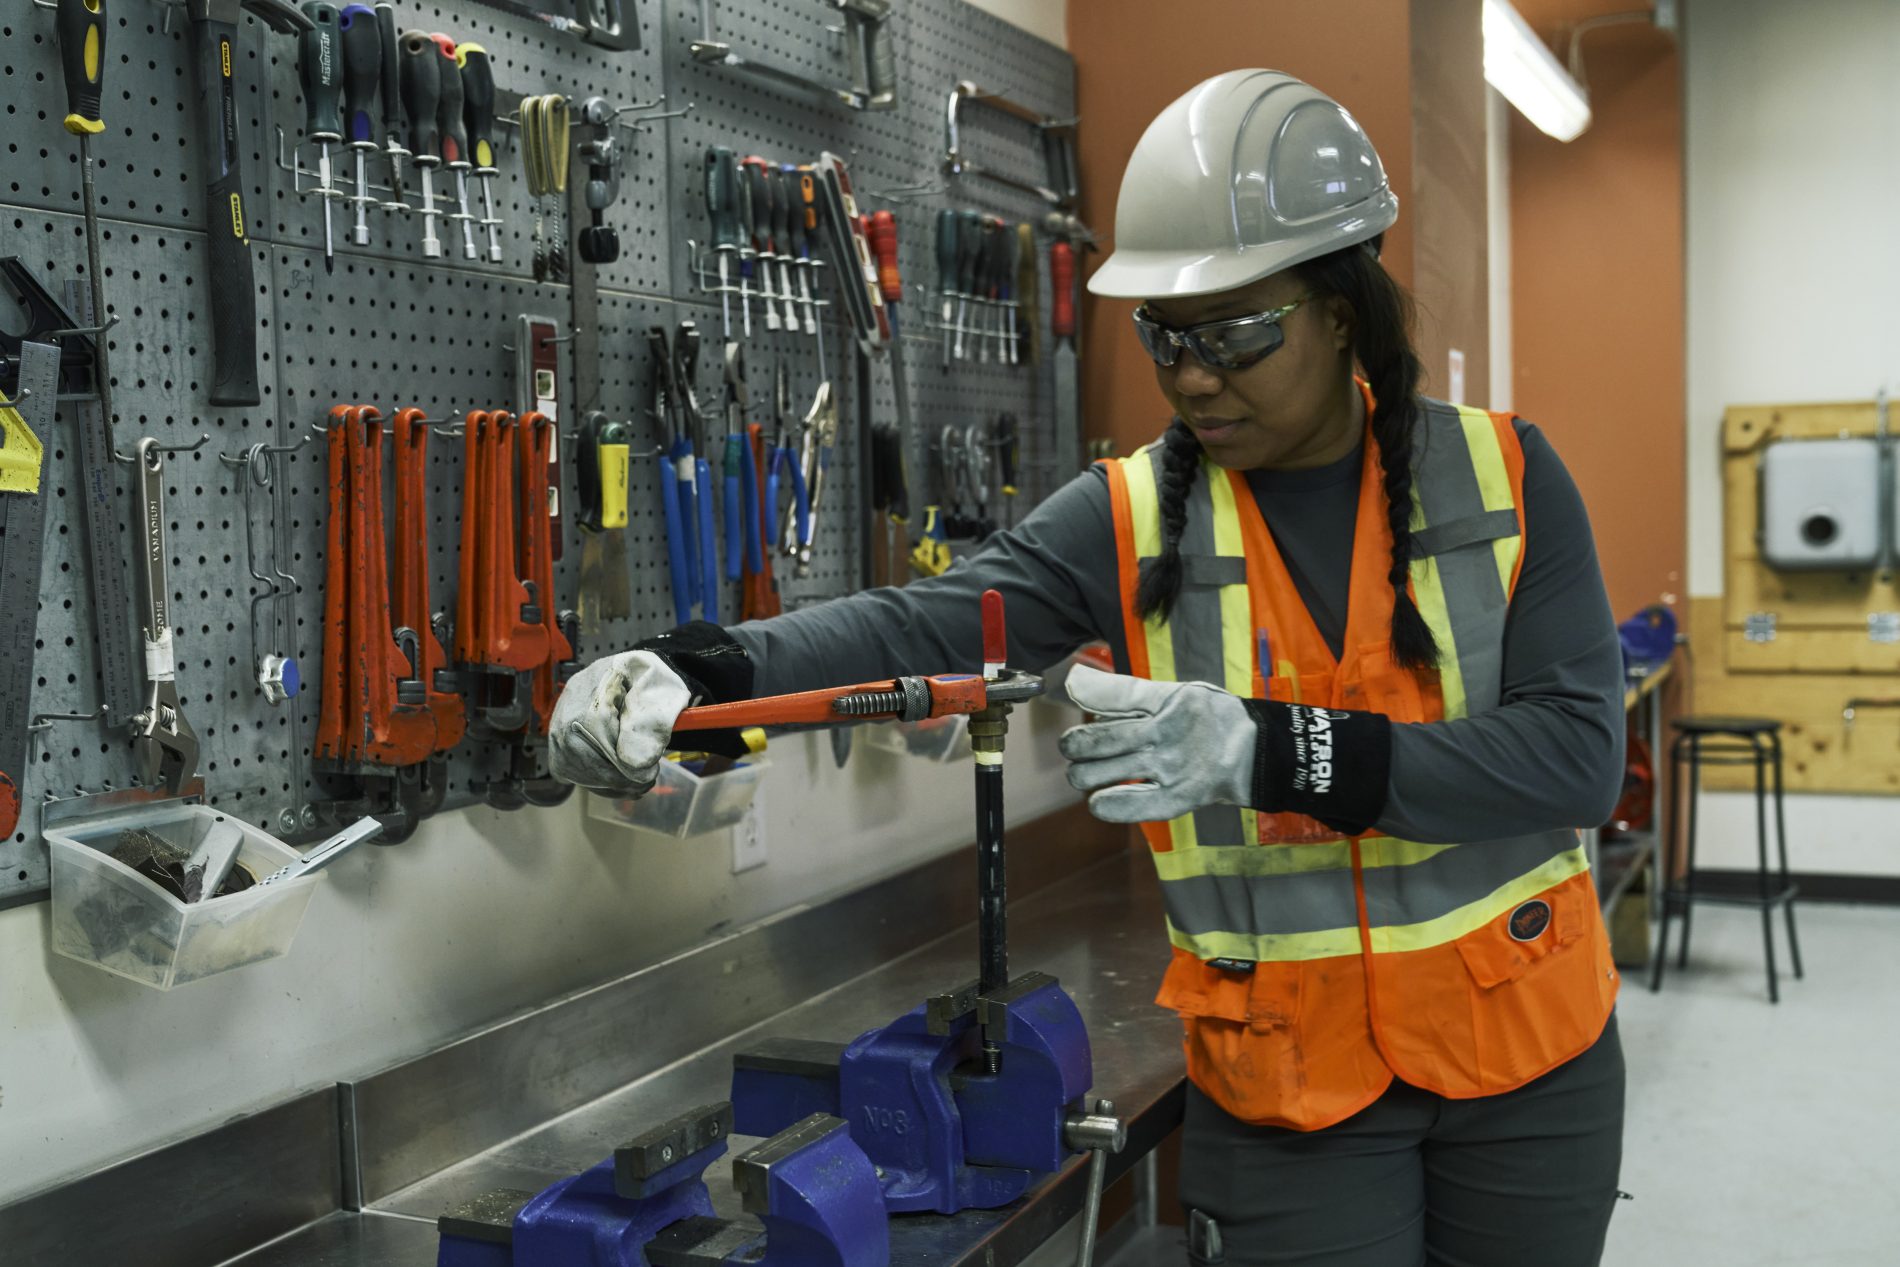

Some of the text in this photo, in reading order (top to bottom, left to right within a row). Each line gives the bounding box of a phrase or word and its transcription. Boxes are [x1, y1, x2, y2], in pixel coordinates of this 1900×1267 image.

[223, 43, 231, 74] STANLEY
[321, 31, 331, 86] Mastercraft
[232, 196, 242, 235] STANLEY
[150, 500, 160, 561] VANADIUM
[1294, 736, 1309, 763] since
